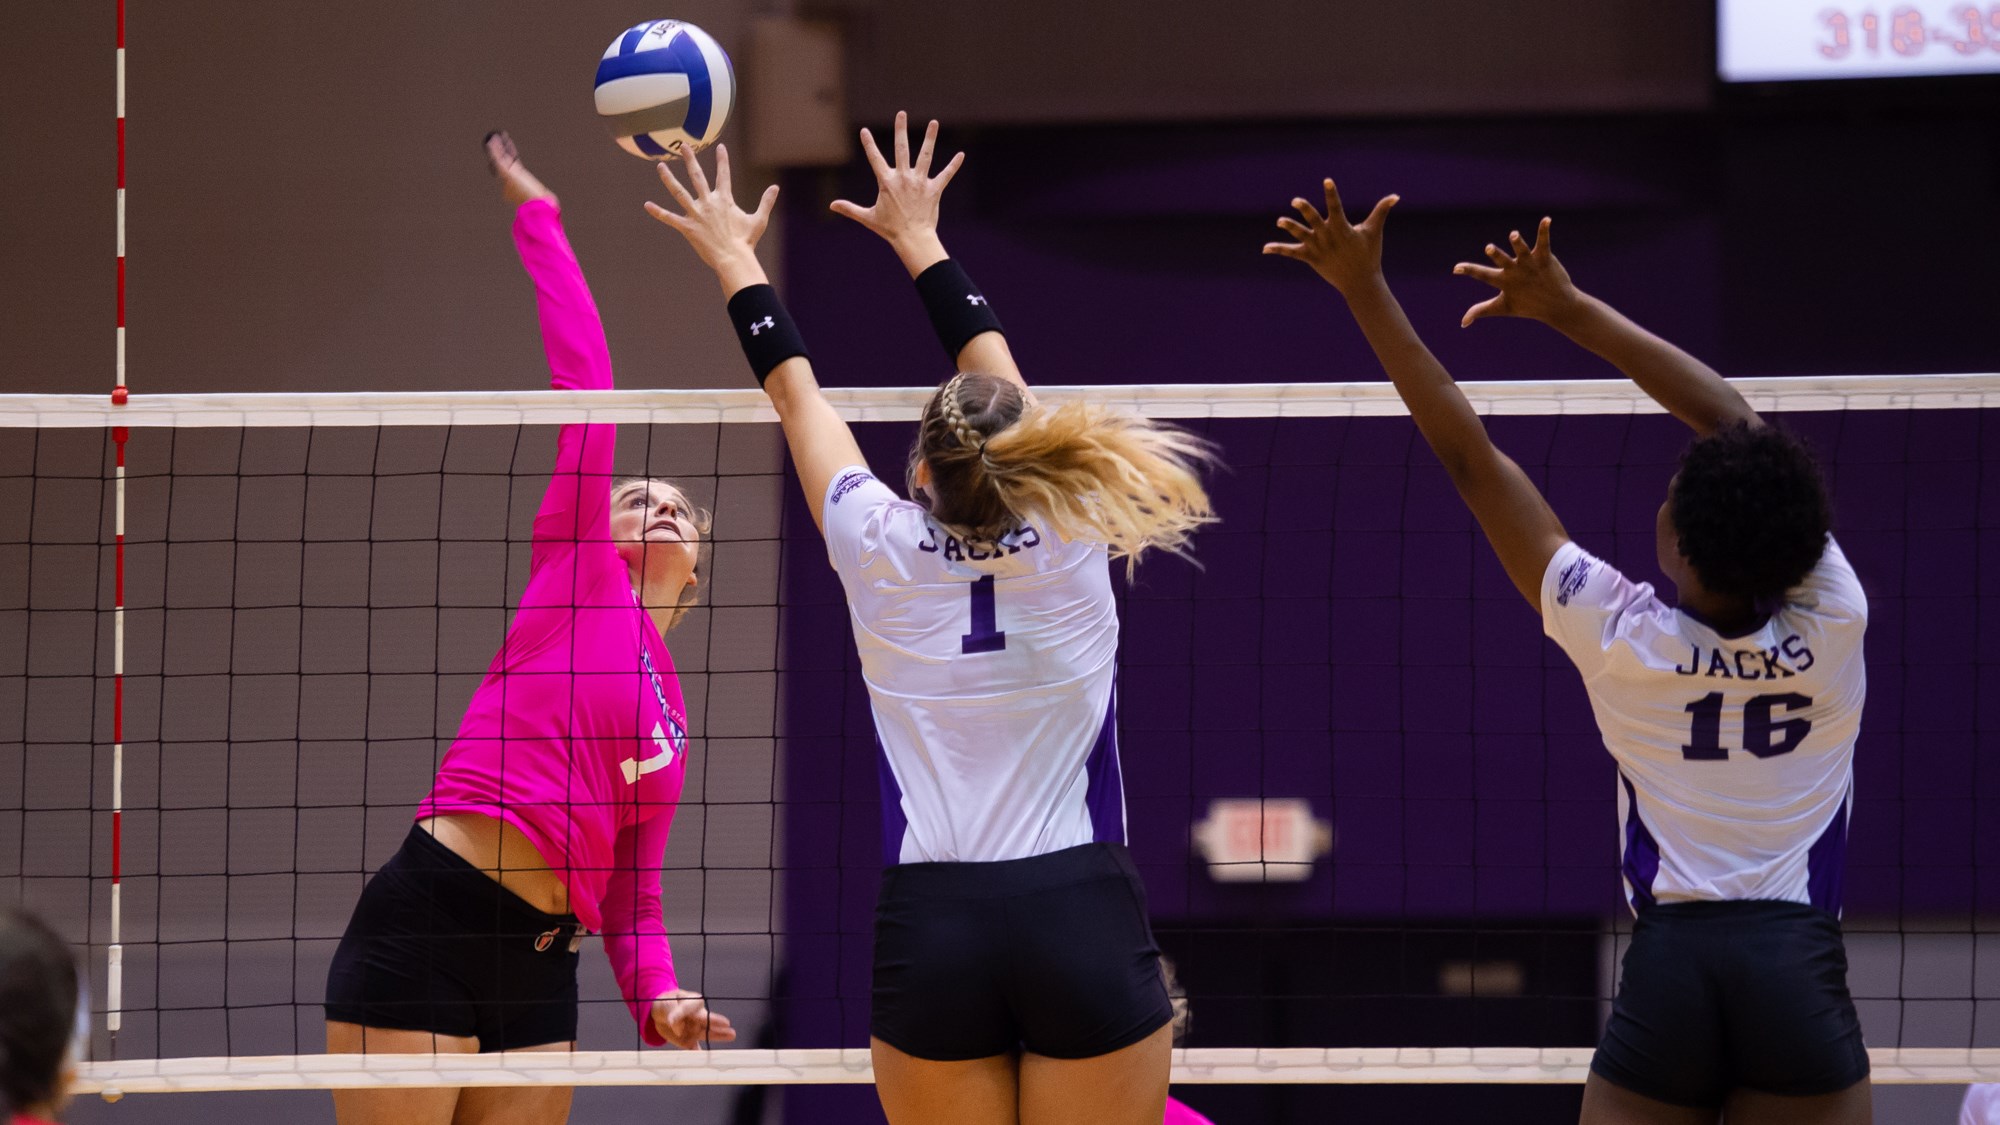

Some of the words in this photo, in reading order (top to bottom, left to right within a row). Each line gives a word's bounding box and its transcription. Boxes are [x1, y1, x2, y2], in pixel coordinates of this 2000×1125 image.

[962, 574, 1006, 654] 1
[1676, 634, 1814, 680] JACKS
[620, 721, 674, 785] 7
[1681, 691, 1813, 760] 16
